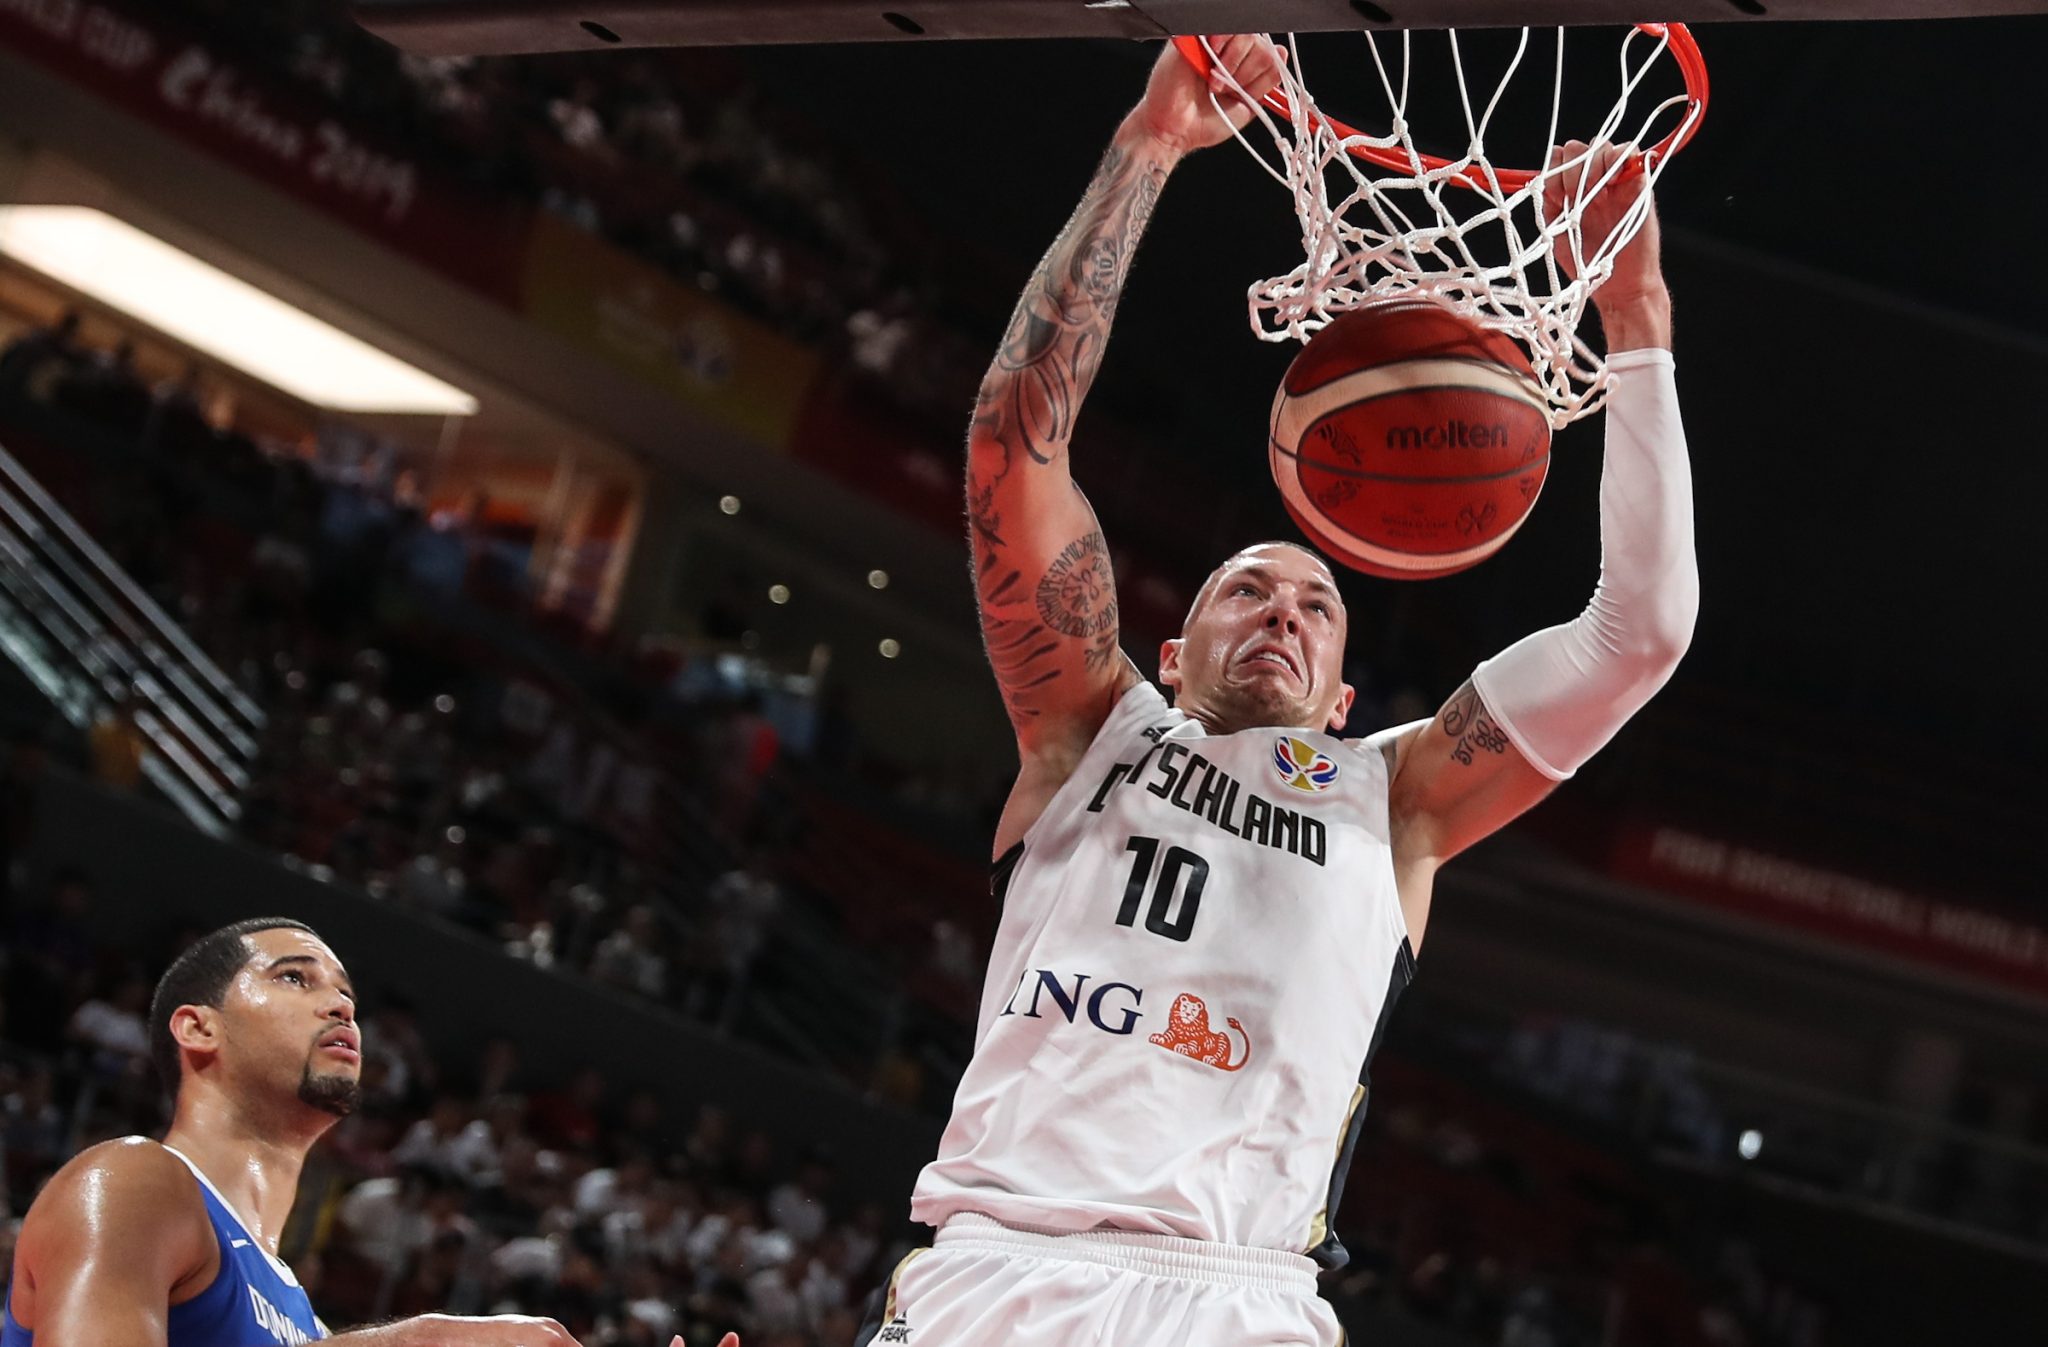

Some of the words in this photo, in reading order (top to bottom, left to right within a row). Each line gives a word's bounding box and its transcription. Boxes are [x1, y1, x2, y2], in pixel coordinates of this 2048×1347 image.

[1386, 419, 1508, 450] molten
[1114, 835, 1210, 942] 10
[1000, 968, 1143, 1035] ING
[879, 1326, 914, 1344] PEAK
